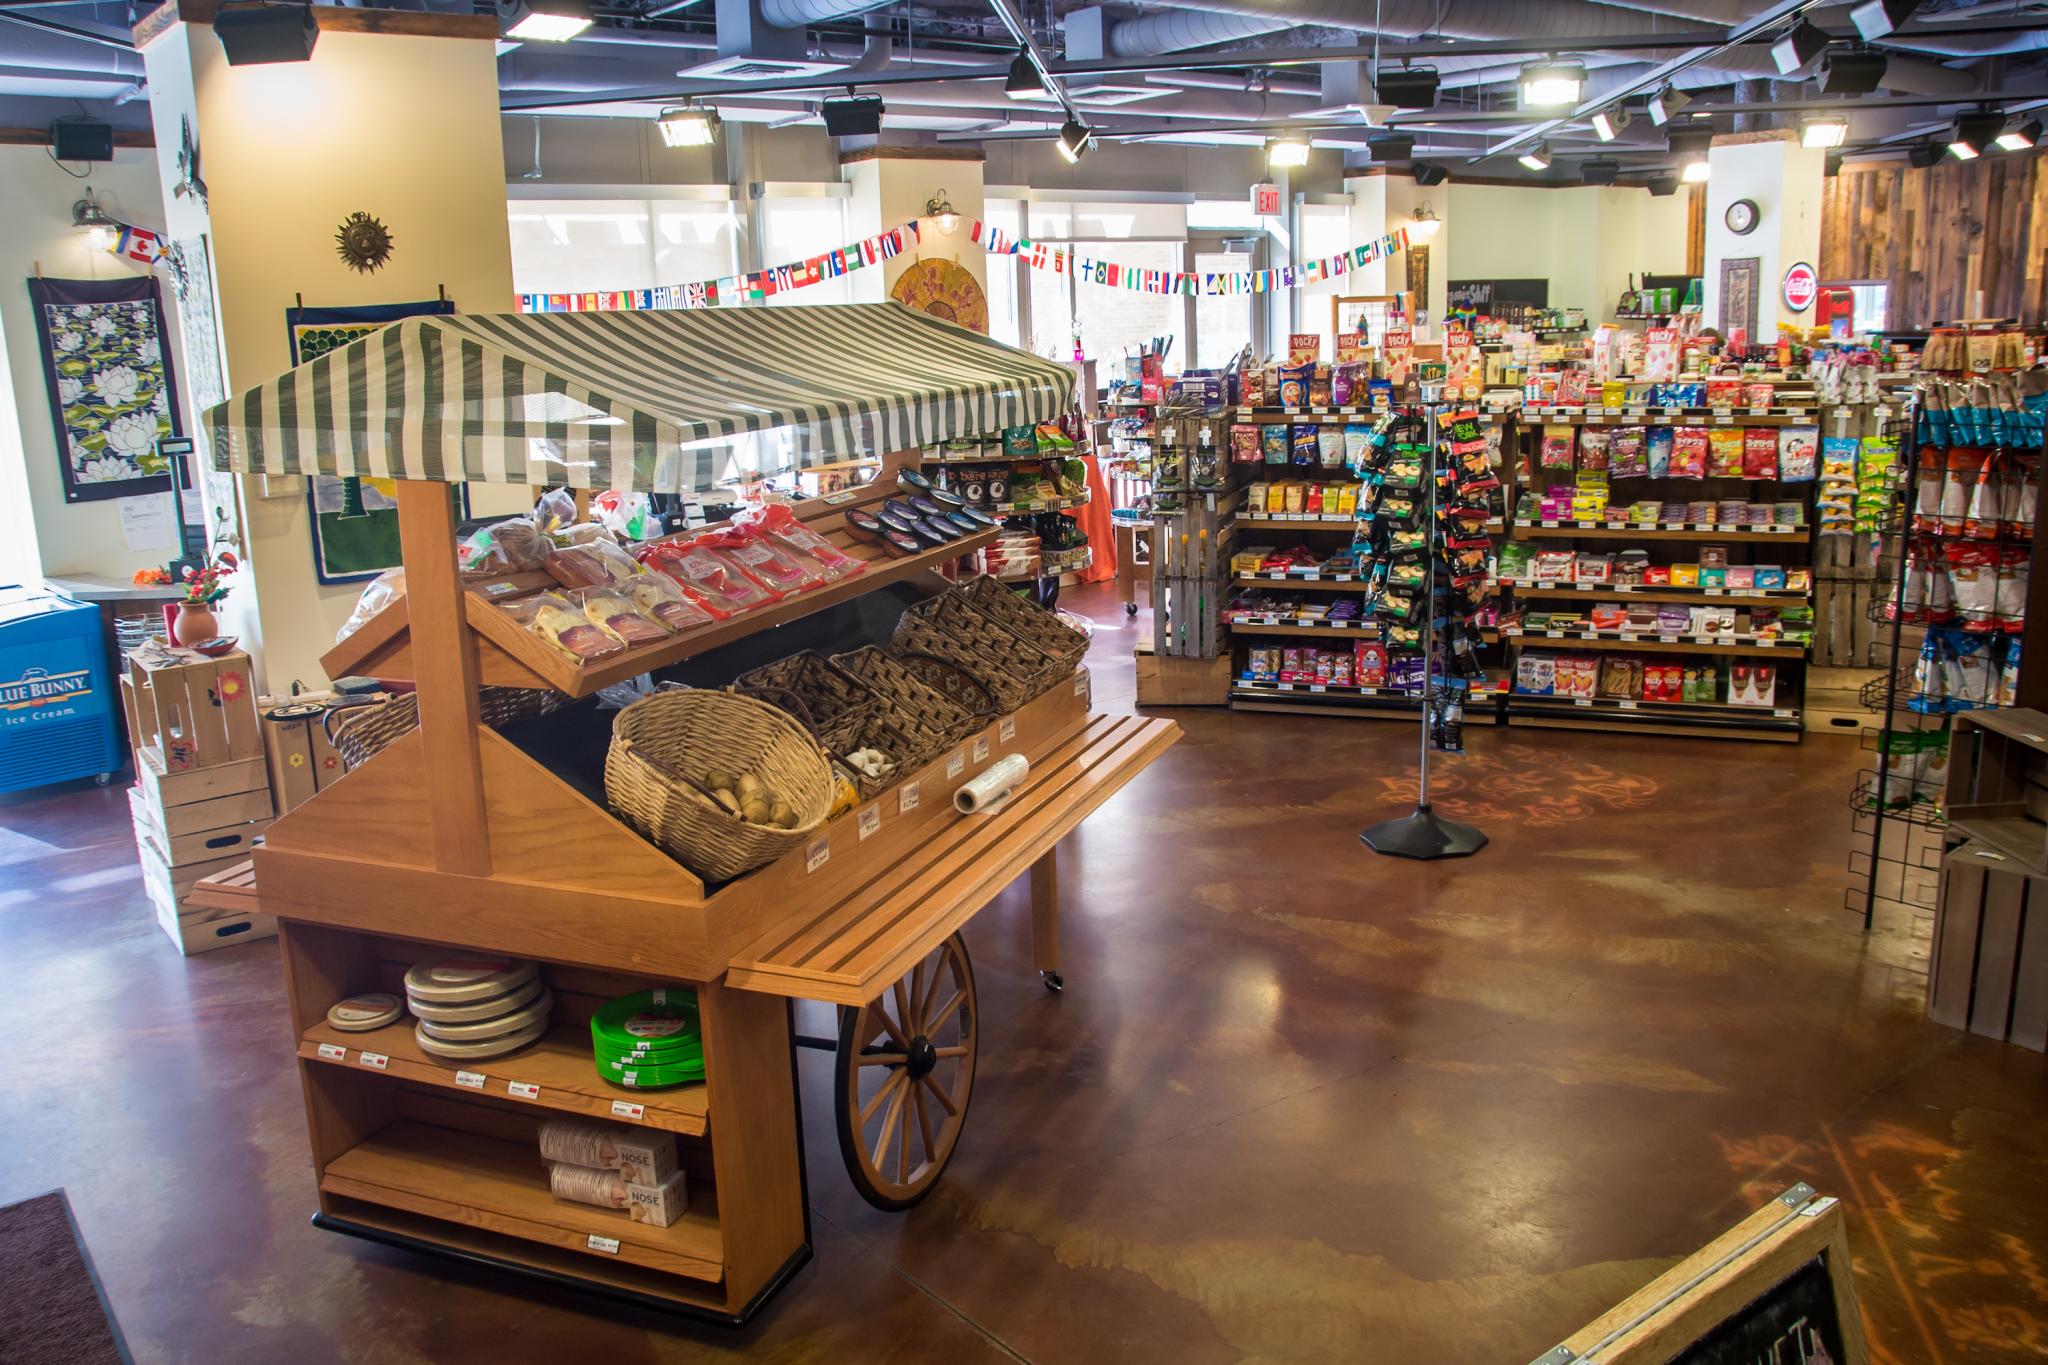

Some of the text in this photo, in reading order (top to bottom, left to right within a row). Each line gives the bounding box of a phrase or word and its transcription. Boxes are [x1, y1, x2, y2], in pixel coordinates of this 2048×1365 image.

[1259, 191, 1279, 213] EXIT
[960, 471, 986, 481] bare
[0, 677, 87, 703] LUE BUNNY
[6, 708, 75, 726] Ice Cream
[621, 1151, 650, 1167] NOSE
[632, 1192, 660, 1206] NOSE
